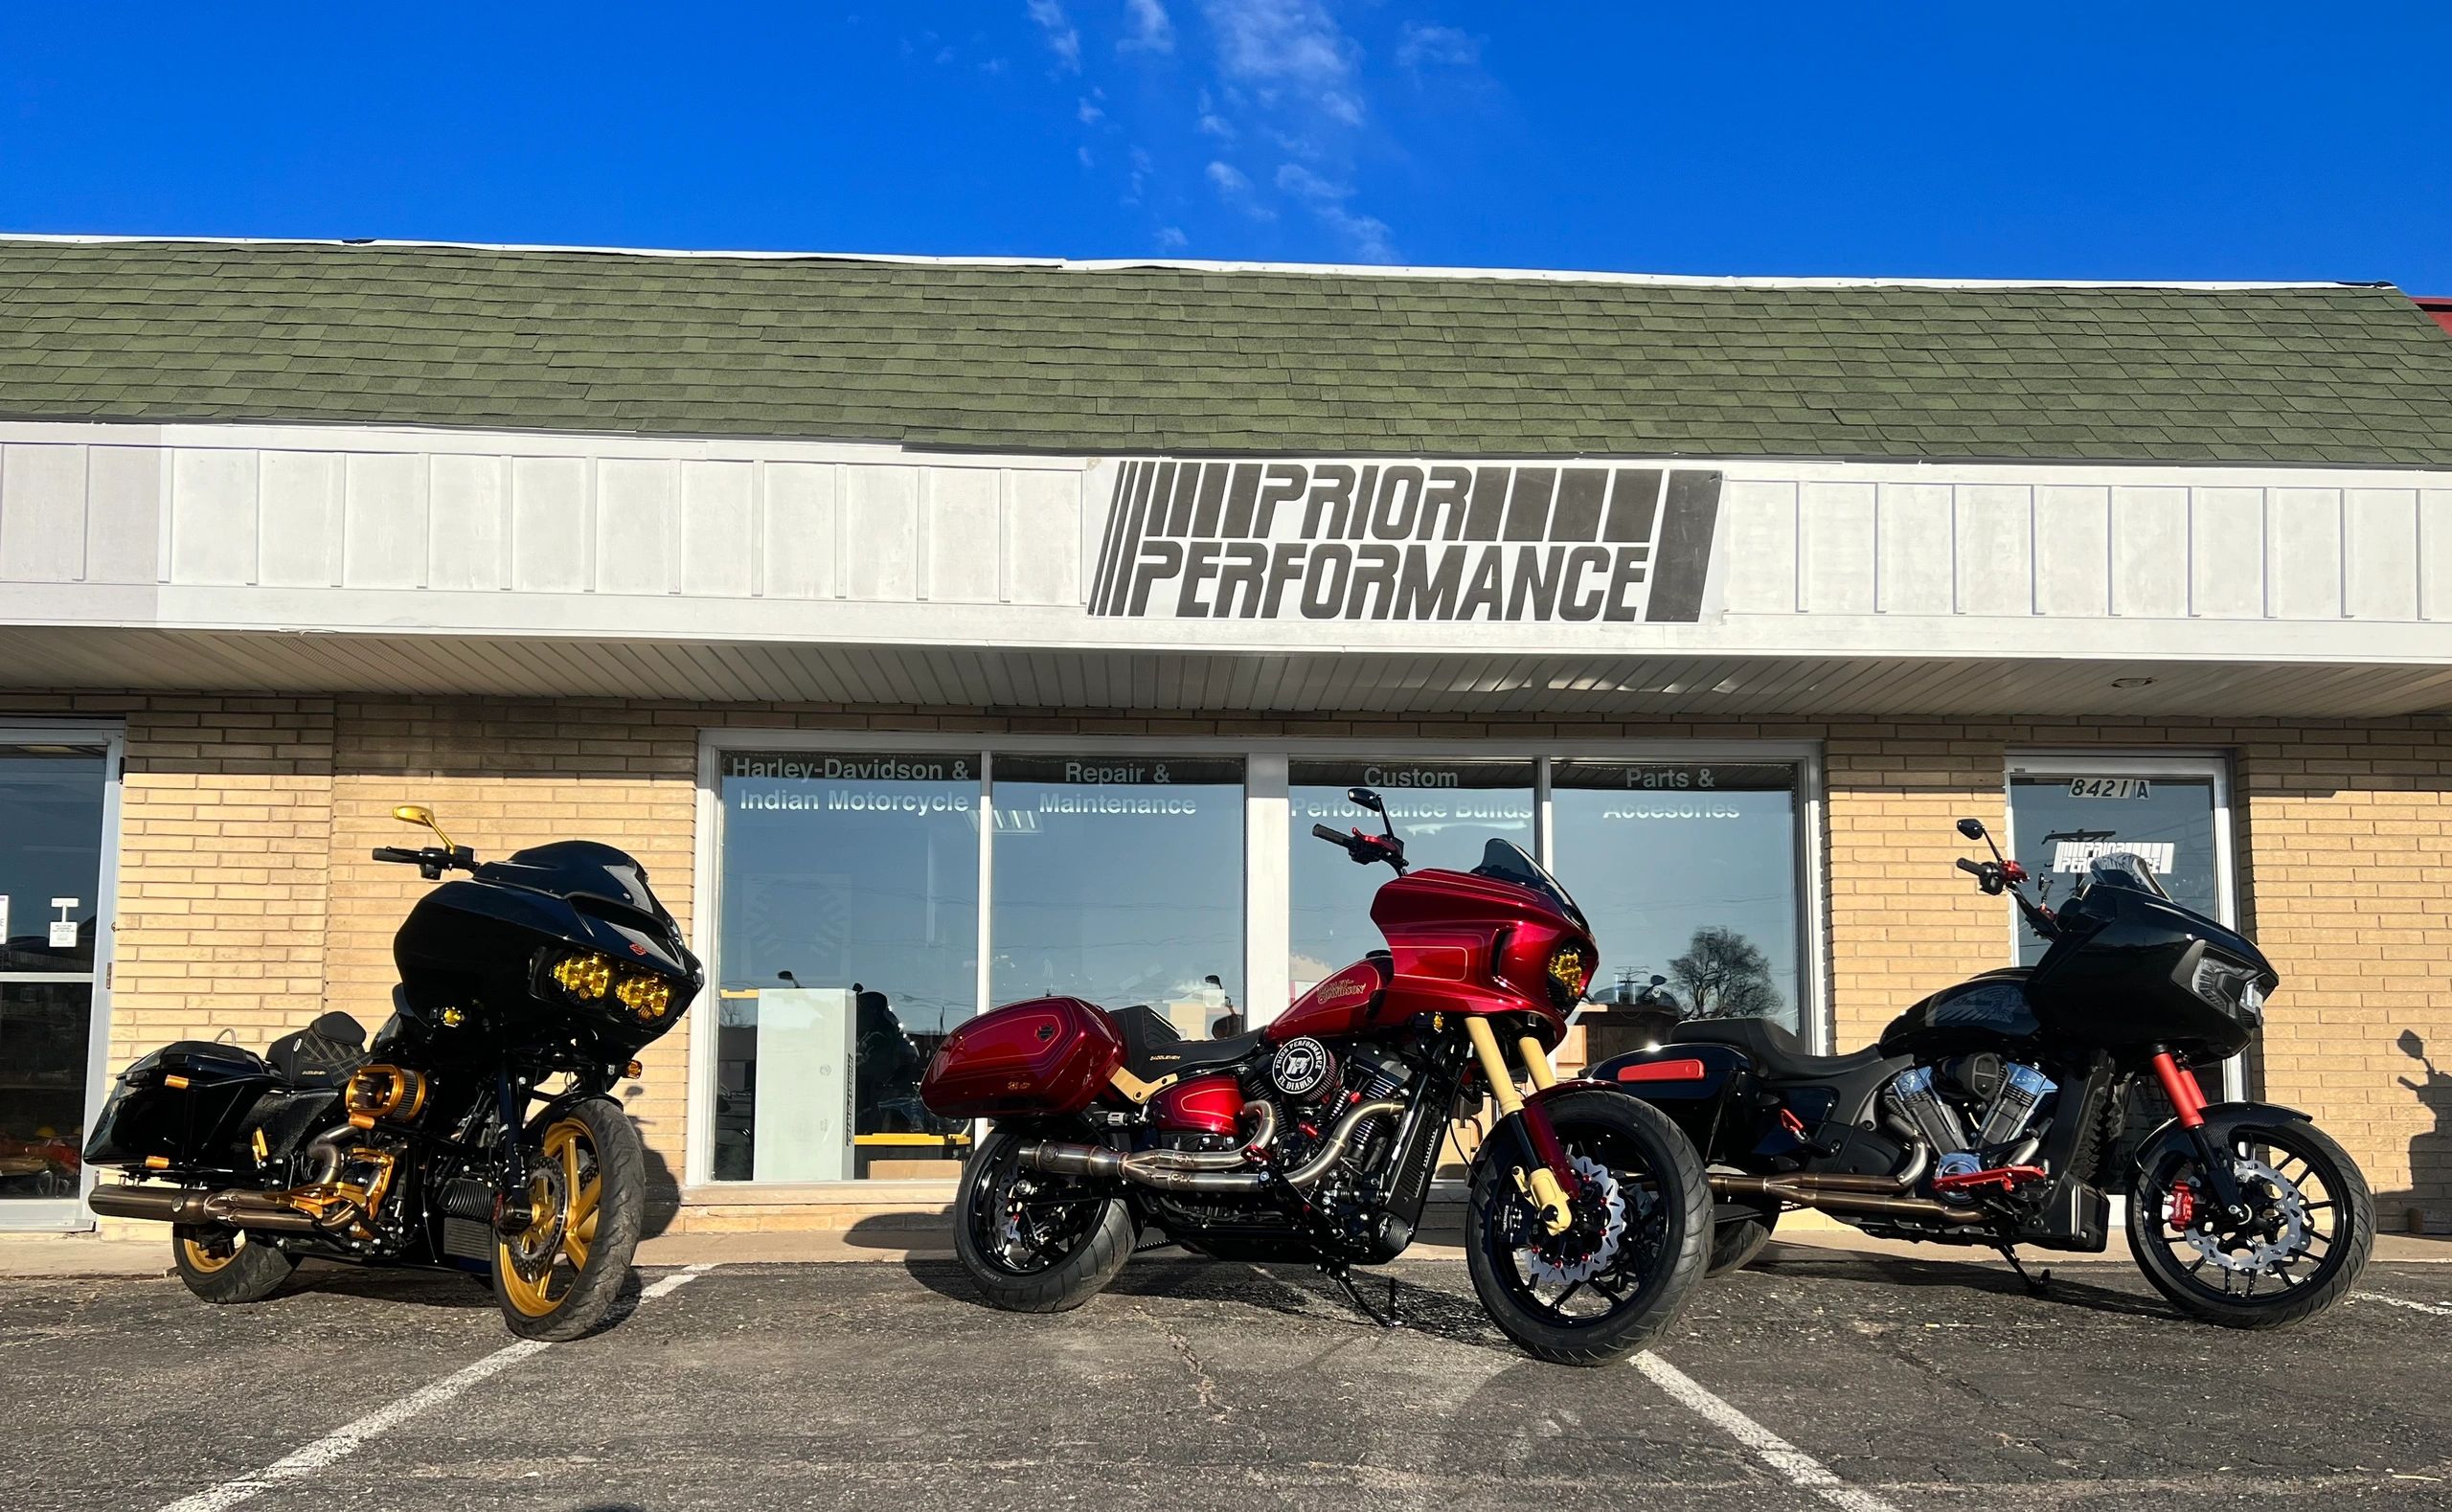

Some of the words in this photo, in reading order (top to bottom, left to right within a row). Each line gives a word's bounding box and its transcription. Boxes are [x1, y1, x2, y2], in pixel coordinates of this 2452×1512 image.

[1252, 463, 1471, 541] PRIOR
[1127, 540, 1649, 622] PERFORMANCE
[732, 757, 942, 783] Harley-Davidson
[951, 760, 970, 780] &
[1065, 762, 1146, 786] Repair
[1153, 764, 1170, 783] &
[1364, 767, 1459, 787] Custom
[1626, 768, 1690, 788] Parts
[1698, 768, 1715, 787] &
[2071, 779, 2128, 798] 8421
[2136, 780, 2148, 798] A
[740, 788, 819, 810] Indian
[828, 789, 969, 816] Motorcycle
[1039, 793, 1196, 814] Maintenance
[1456, 798, 1532, 818] Builds
[1603, 798, 1740, 819] Accesories
[1289, 1040, 1323, 1070] PERFORMANCE
[1285, 1076, 1313, 1091] DIABLO
